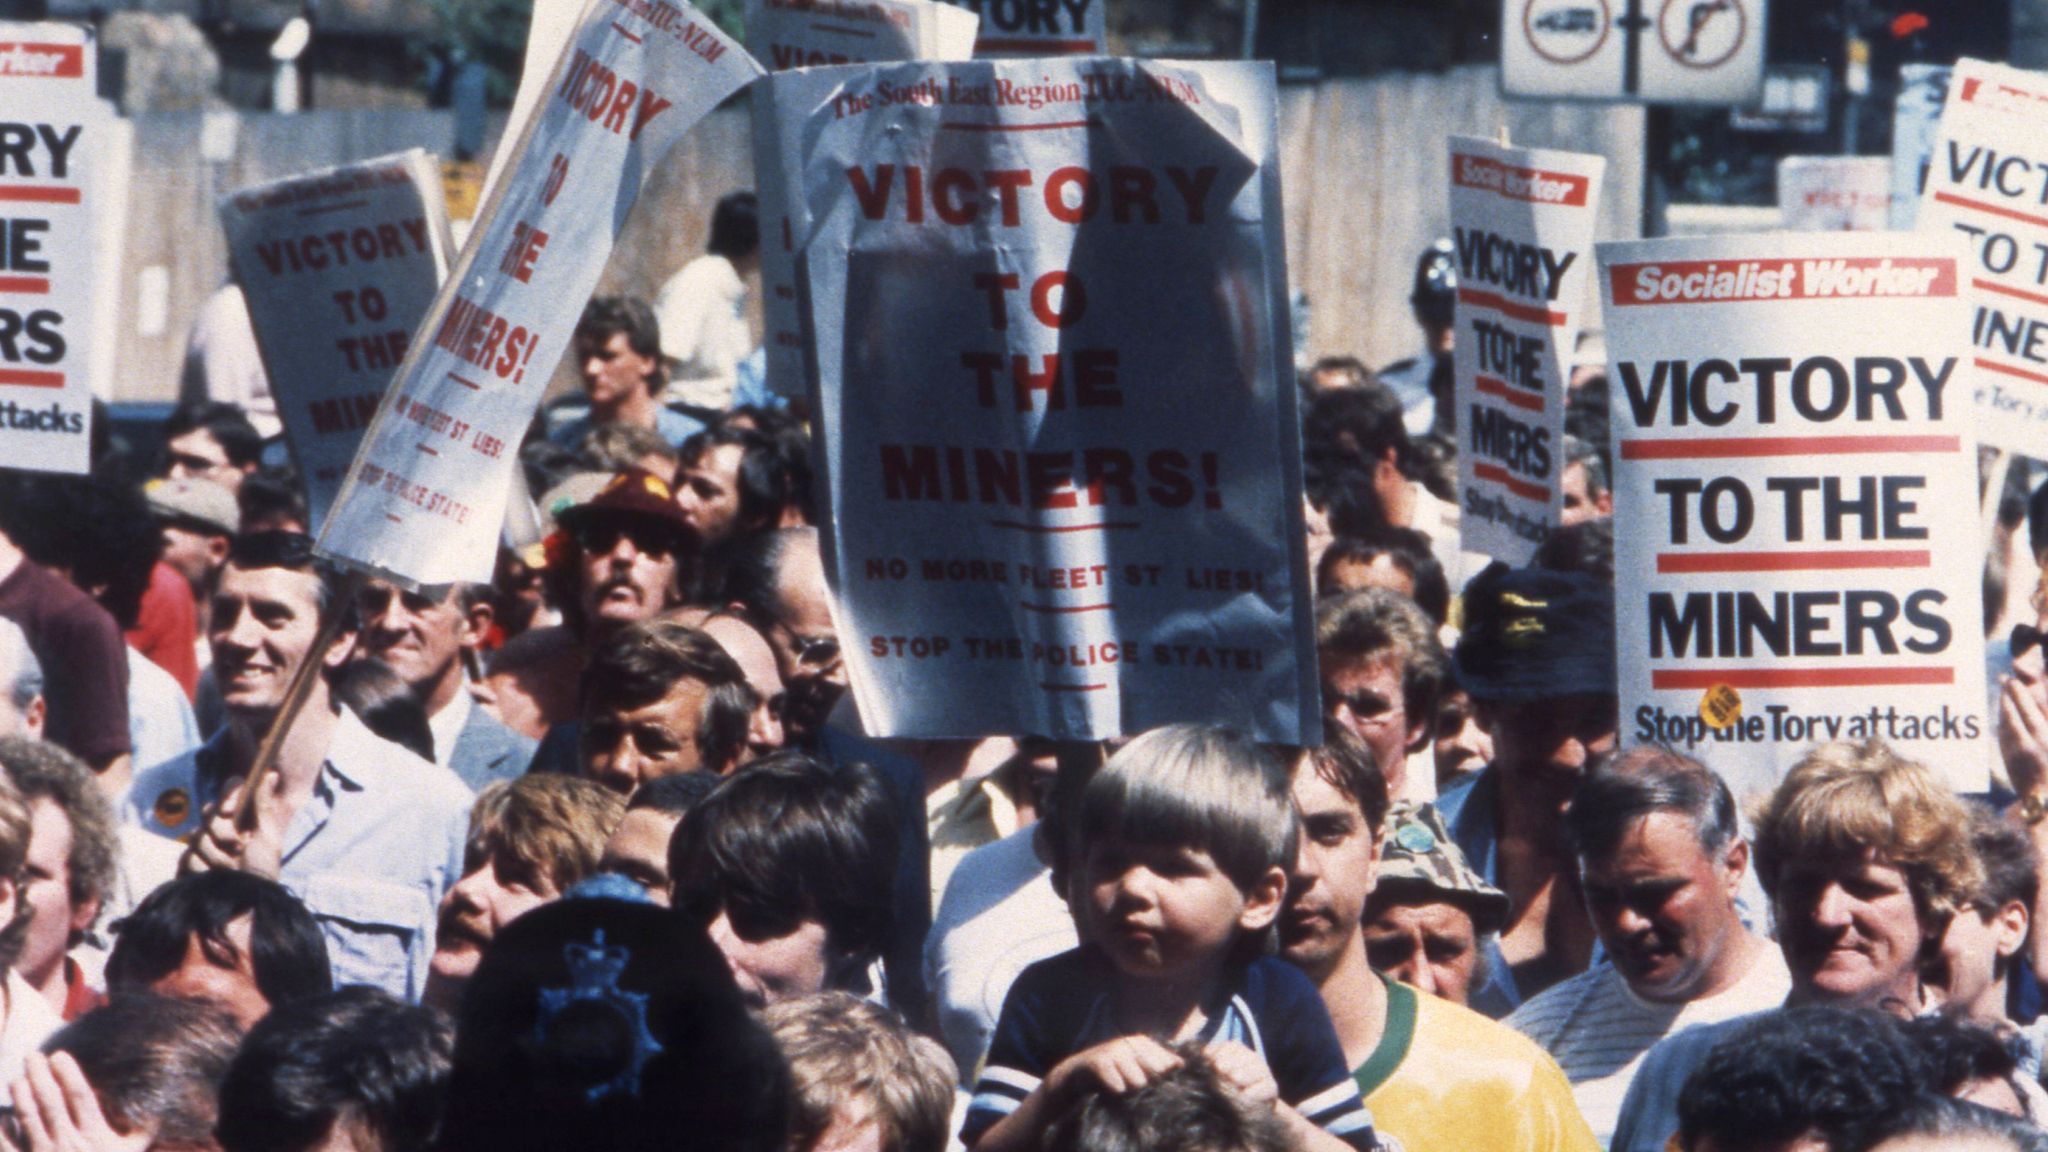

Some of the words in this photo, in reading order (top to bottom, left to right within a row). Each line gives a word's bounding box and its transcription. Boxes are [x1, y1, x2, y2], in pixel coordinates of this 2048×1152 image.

[833, 92, 872, 119] The
[876, 77, 943, 106] South
[995, 76, 1081, 109] Region
[847, 162, 1219, 228] VICTORY
[256, 216, 428, 275] VICTORY
[333, 287, 387, 325] TO
[975, 271, 1086, 330] TO
[1635, 265, 1797, 301] Socialist
[1804, 258, 1940, 297] Worker
[961, 348, 1124, 412] THE
[1618, 356, 1958, 427] VICTORY
[880, 445, 1224, 510] MINERS!
[1655, 476, 1755, 545] TO
[1766, 476, 1929, 542] THE
[866, 558, 907, 581] NO
[921, 559, 1007, 582] MORE
[1020, 565, 1107, 590] FLEET
[1125, 564, 1162, 585] ST
[1187, 568, 1263, 592] LIES!
[1648, 588, 1953, 658] MINERS
[871, 635, 950, 659] STOP
[963, 637, 1022, 660] THE
[1033, 641, 1139, 667] POLICE
[1154, 642, 1263, 671] STATE!
[1635, 705, 1705, 750] Stop
[1849, 706, 1980, 741] attacks
